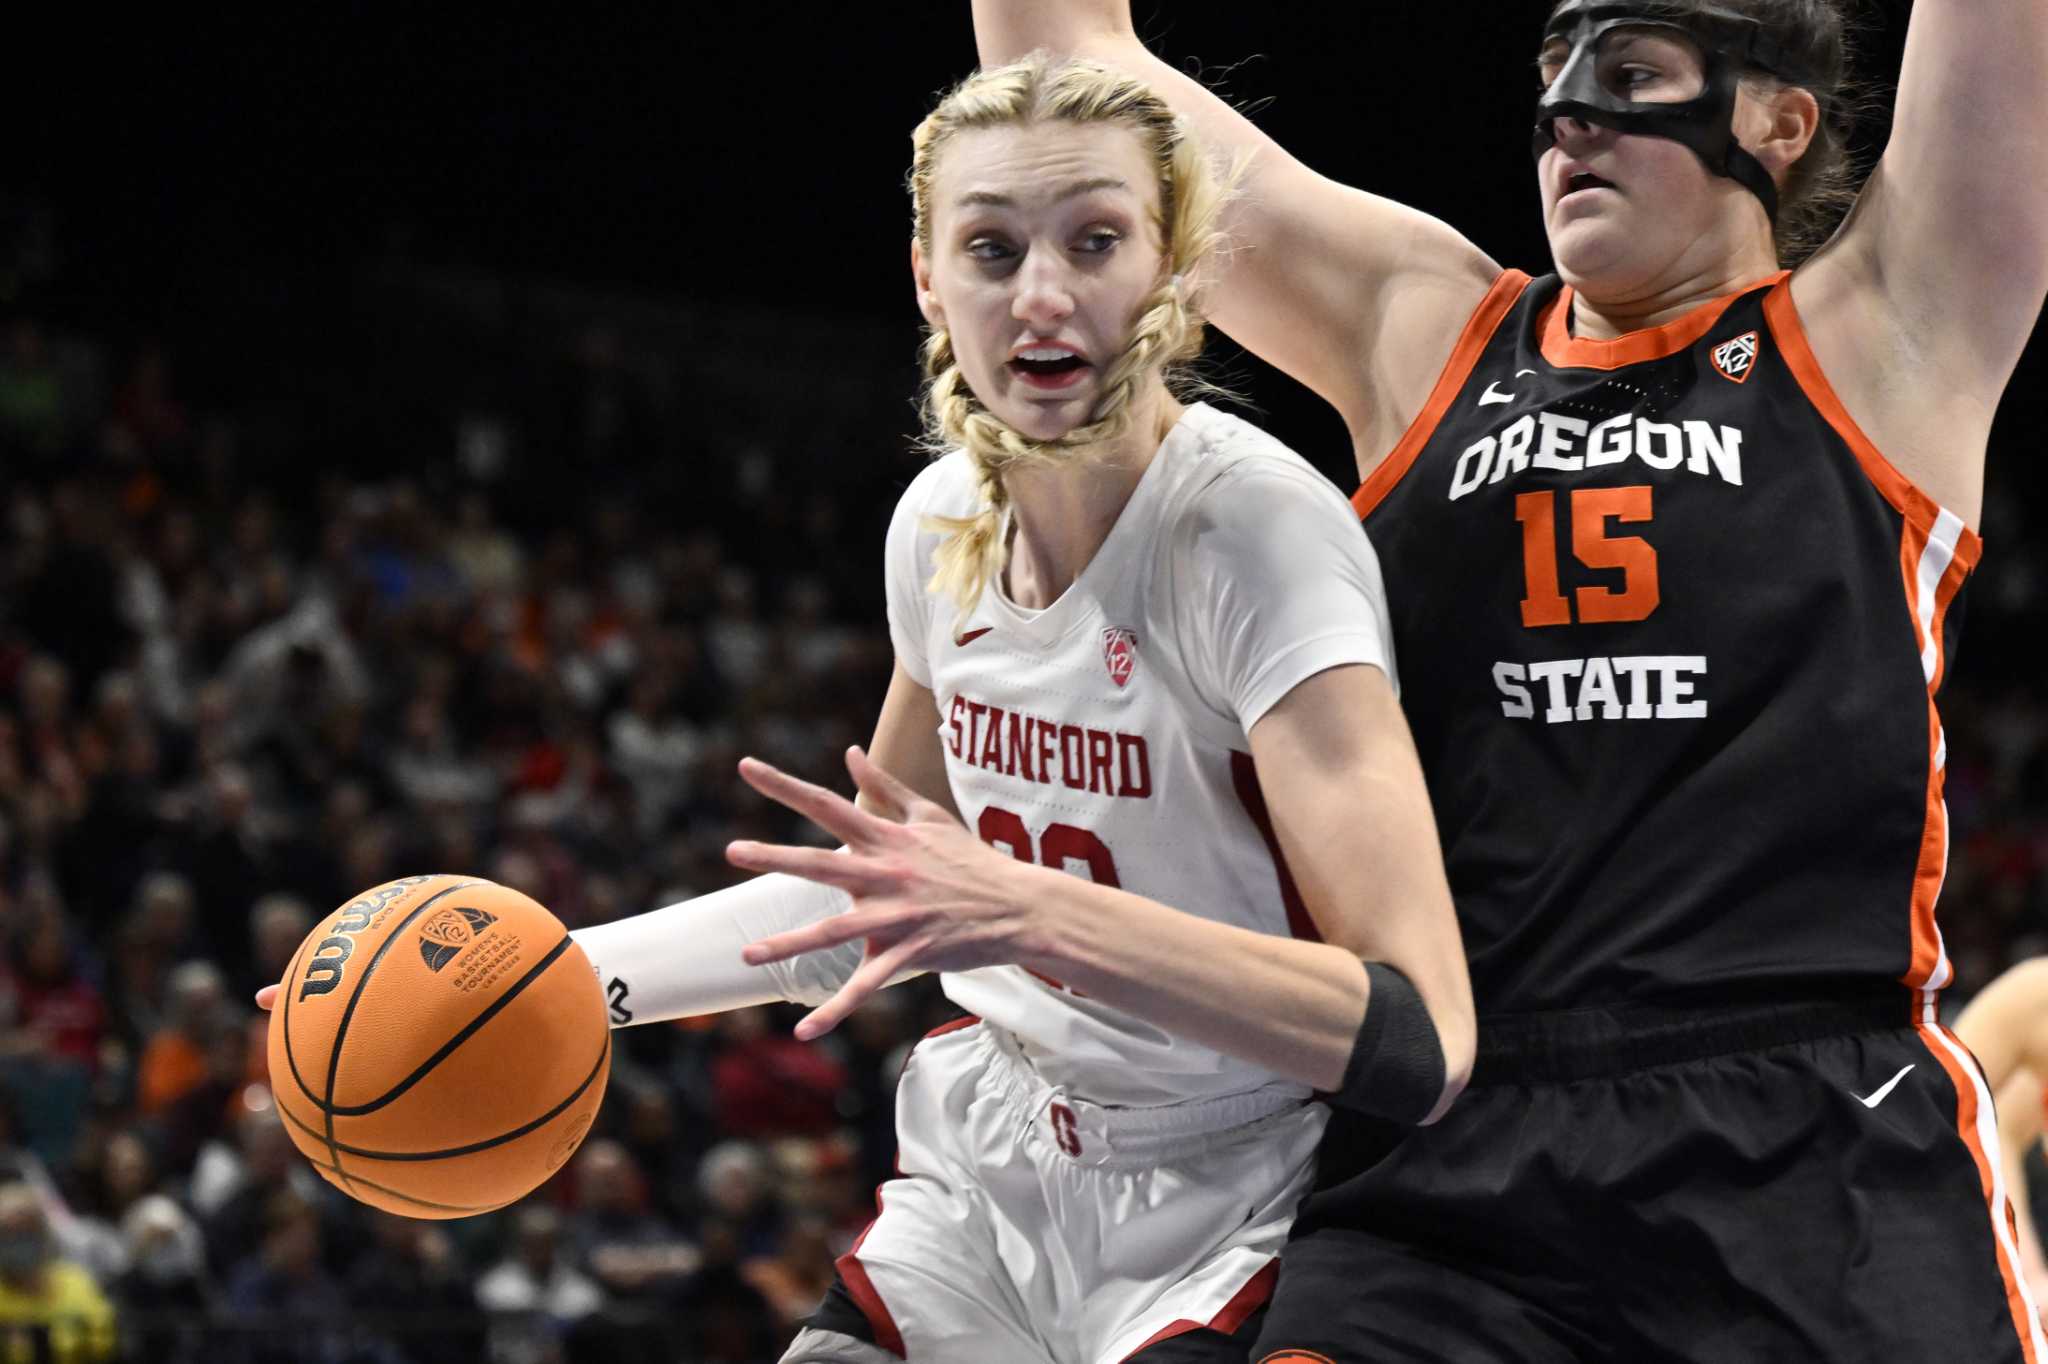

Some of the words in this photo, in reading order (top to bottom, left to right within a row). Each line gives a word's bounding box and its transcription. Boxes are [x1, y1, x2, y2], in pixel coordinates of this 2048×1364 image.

[1713, 333, 1755, 369] PAC
[1726, 352, 1749, 374] 12
[1448, 411, 1743, 501] OREGON
[1515, 485, 1660, 628] 15
[1110, 653, 1131, 675] 12
[1492, 655, 1708, 724] STATE
[948, 693, 1153, 799] STANFORD
[298, 874, 432, 1003] Wilso
[453, 933, 520, 988] BASKETBALL
[457, 932, 499, 969] WOMEN'S
[460, 938, 521, 993] TOURNAMENT
